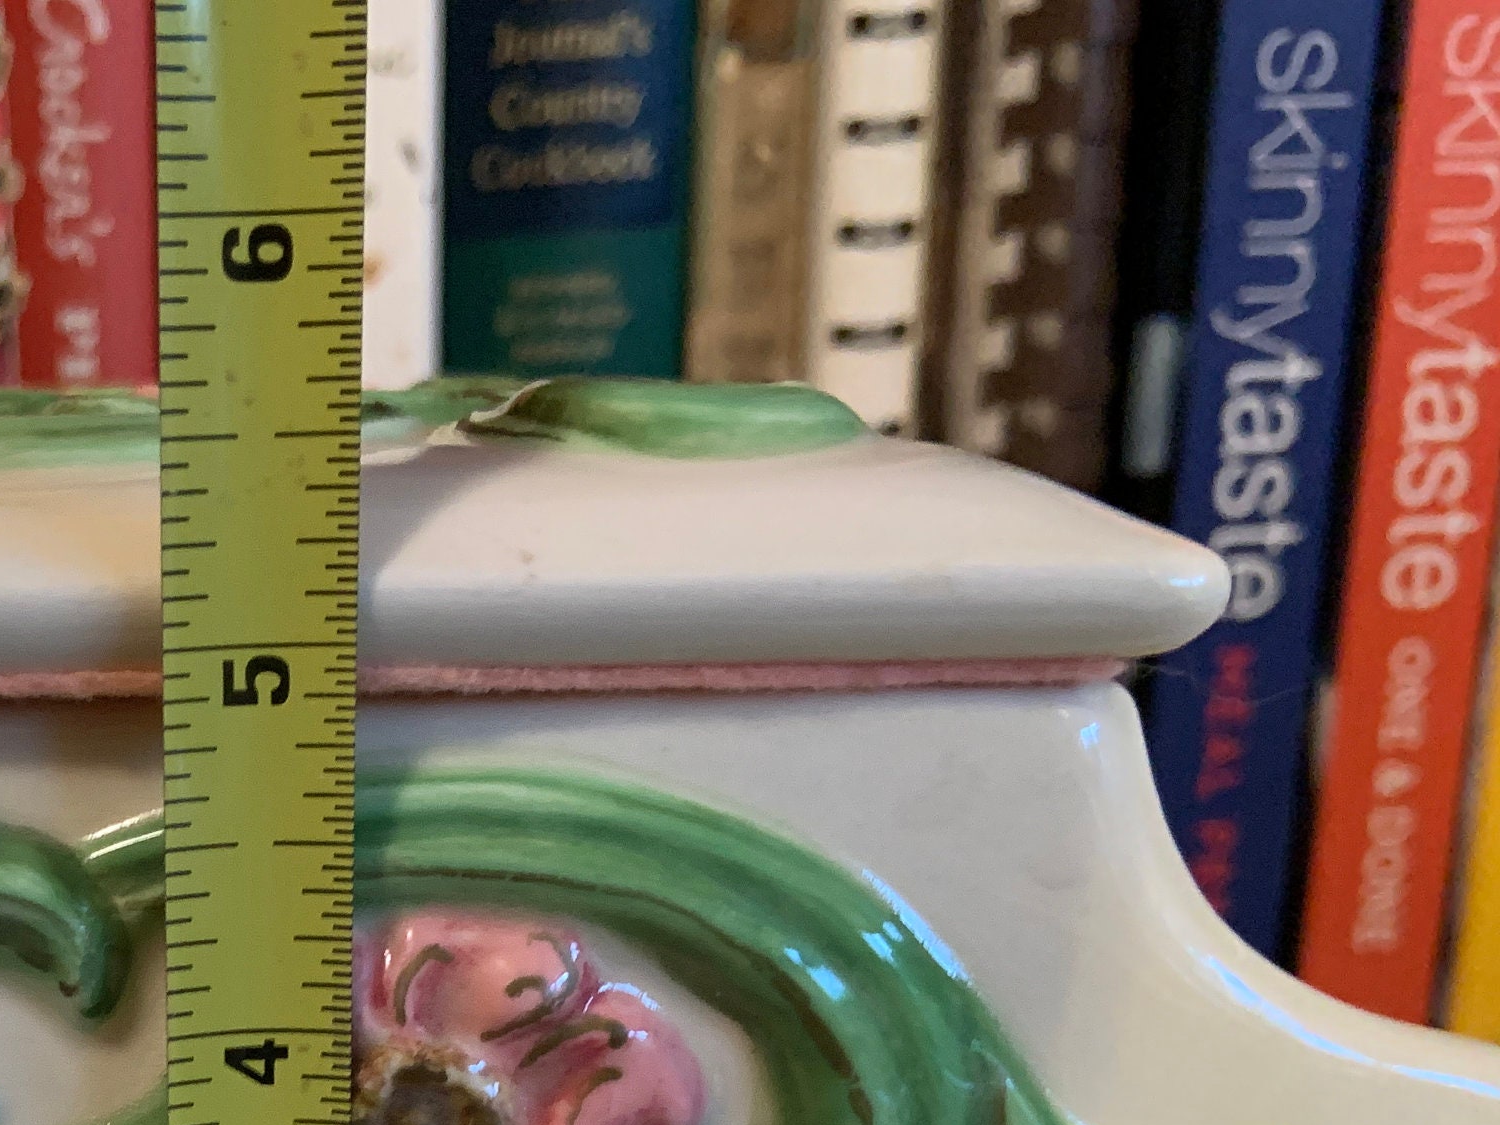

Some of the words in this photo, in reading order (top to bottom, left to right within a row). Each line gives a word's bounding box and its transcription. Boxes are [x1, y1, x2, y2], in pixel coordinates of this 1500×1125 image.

[222, 223, 294, 282] 6
[1208, 27, 1354, 622] skinnytaste
[1380, 13, 1500, 611] skinnytaste
[222, 654, 290, 707] 5
[1376, 635, 1436, 750] ONE
[1351, 804, 1418, 955] DONE
[224, 1038, 289, 1085] 4
